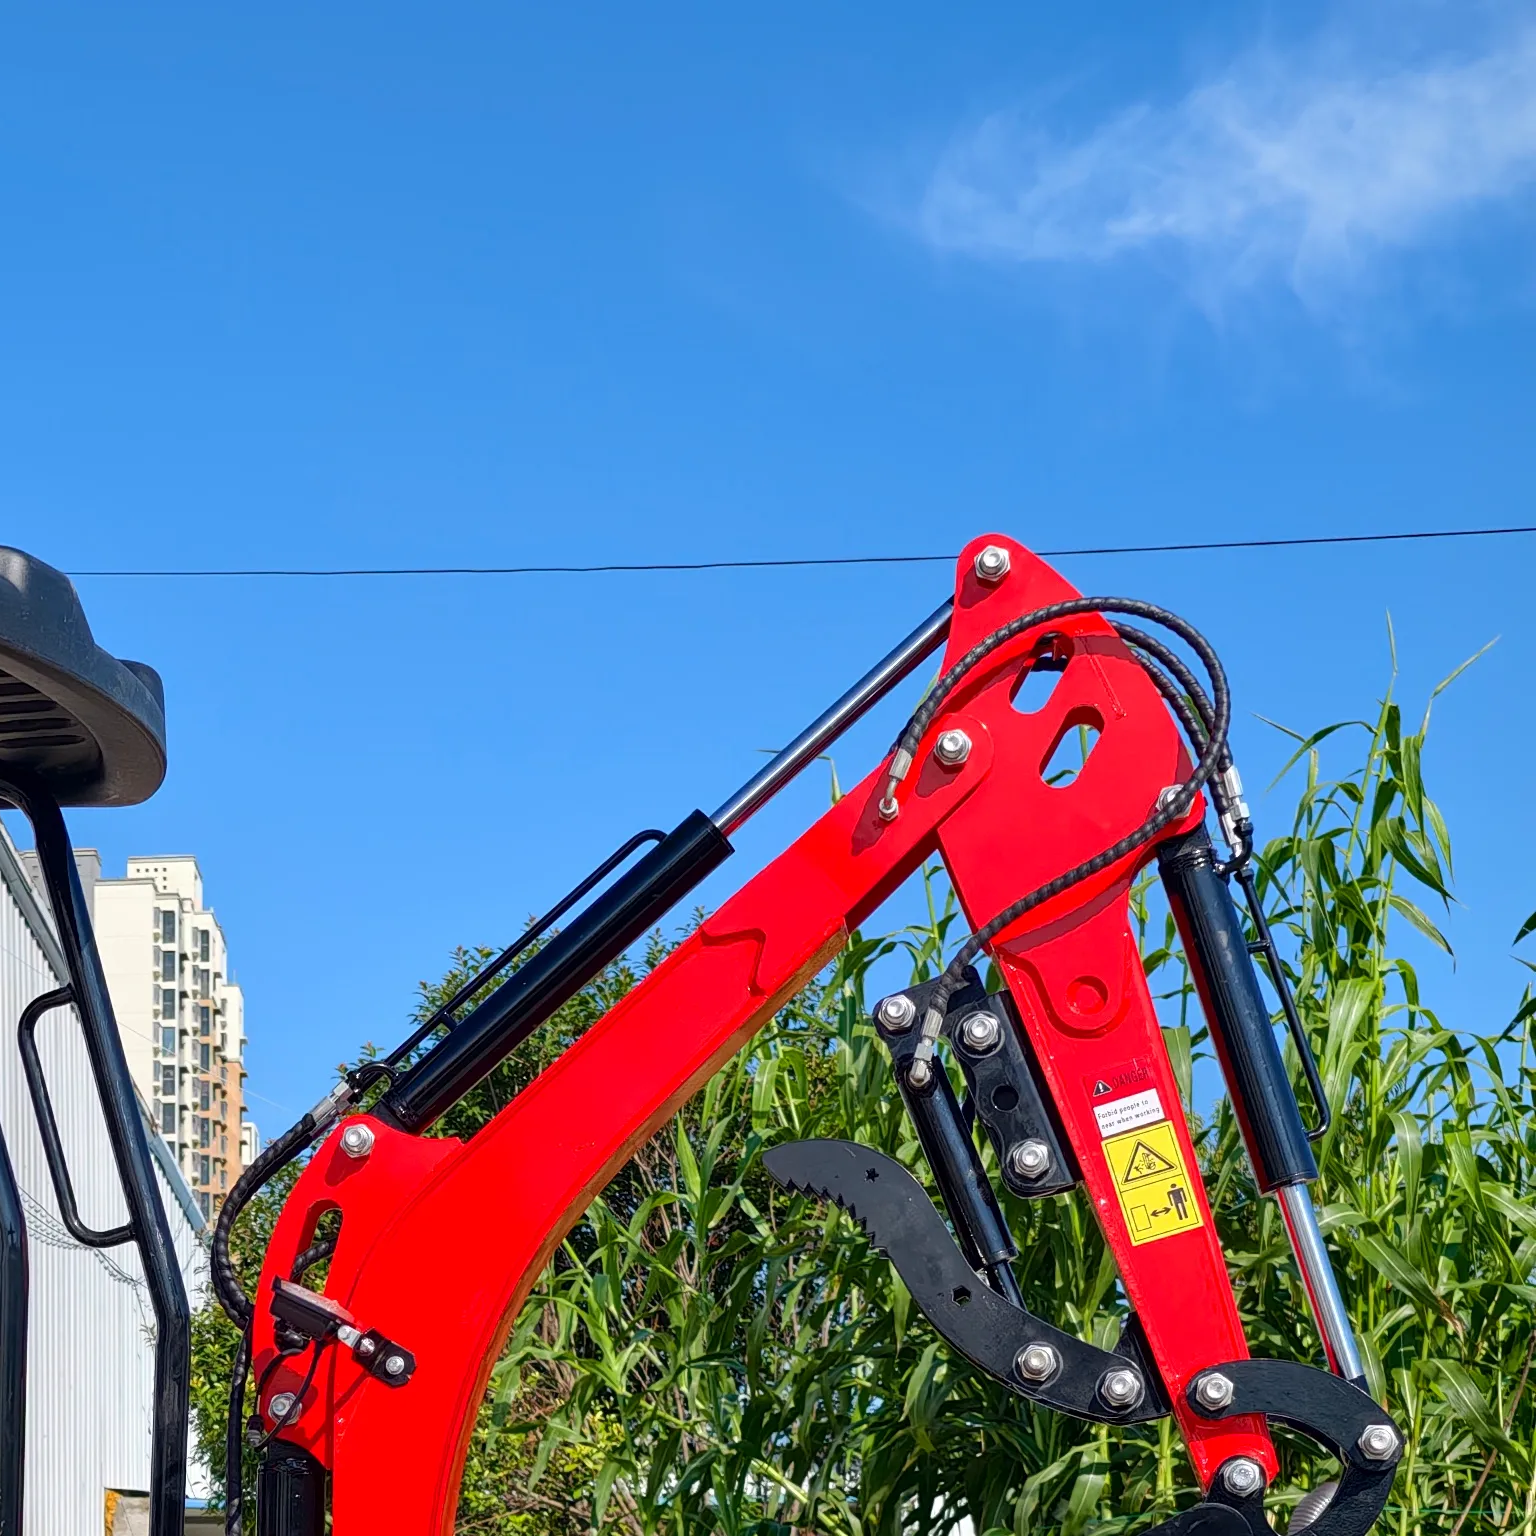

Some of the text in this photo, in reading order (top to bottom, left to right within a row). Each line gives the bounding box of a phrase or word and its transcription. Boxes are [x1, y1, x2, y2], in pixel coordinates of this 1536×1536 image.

[1112, 1067, 1148, 1089] DANGER
[1097, 1108, 1118, 1120] Forbid
[1119, 1102, 1140, 1114] people
[1101, 1107, 1160, 1129] near when working
